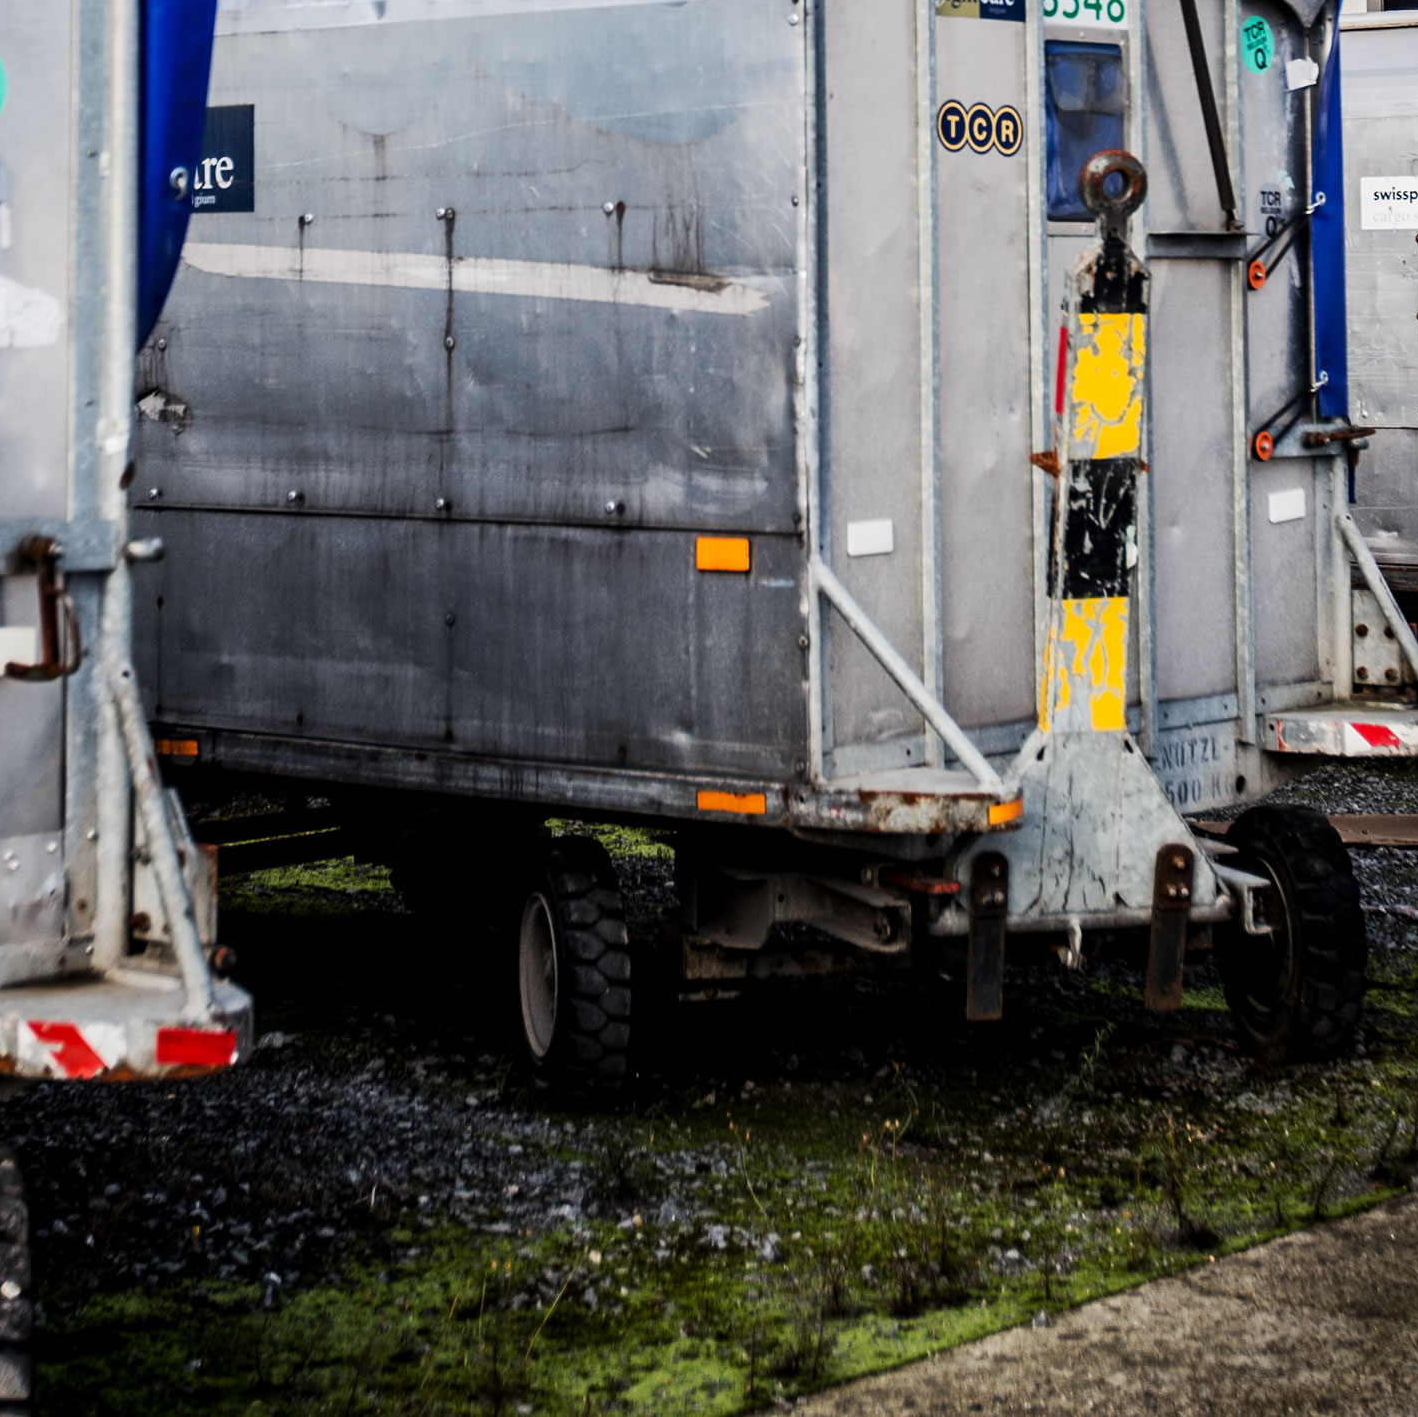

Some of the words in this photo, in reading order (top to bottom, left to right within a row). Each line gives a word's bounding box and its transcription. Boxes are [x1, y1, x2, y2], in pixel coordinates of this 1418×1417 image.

[1244, 21, 1267, 42] TCR
[1255, 47, 1268, 70] Q
[946, 114, 1015, 143] TCR
[1260, 190, 1282, 206] TCR
